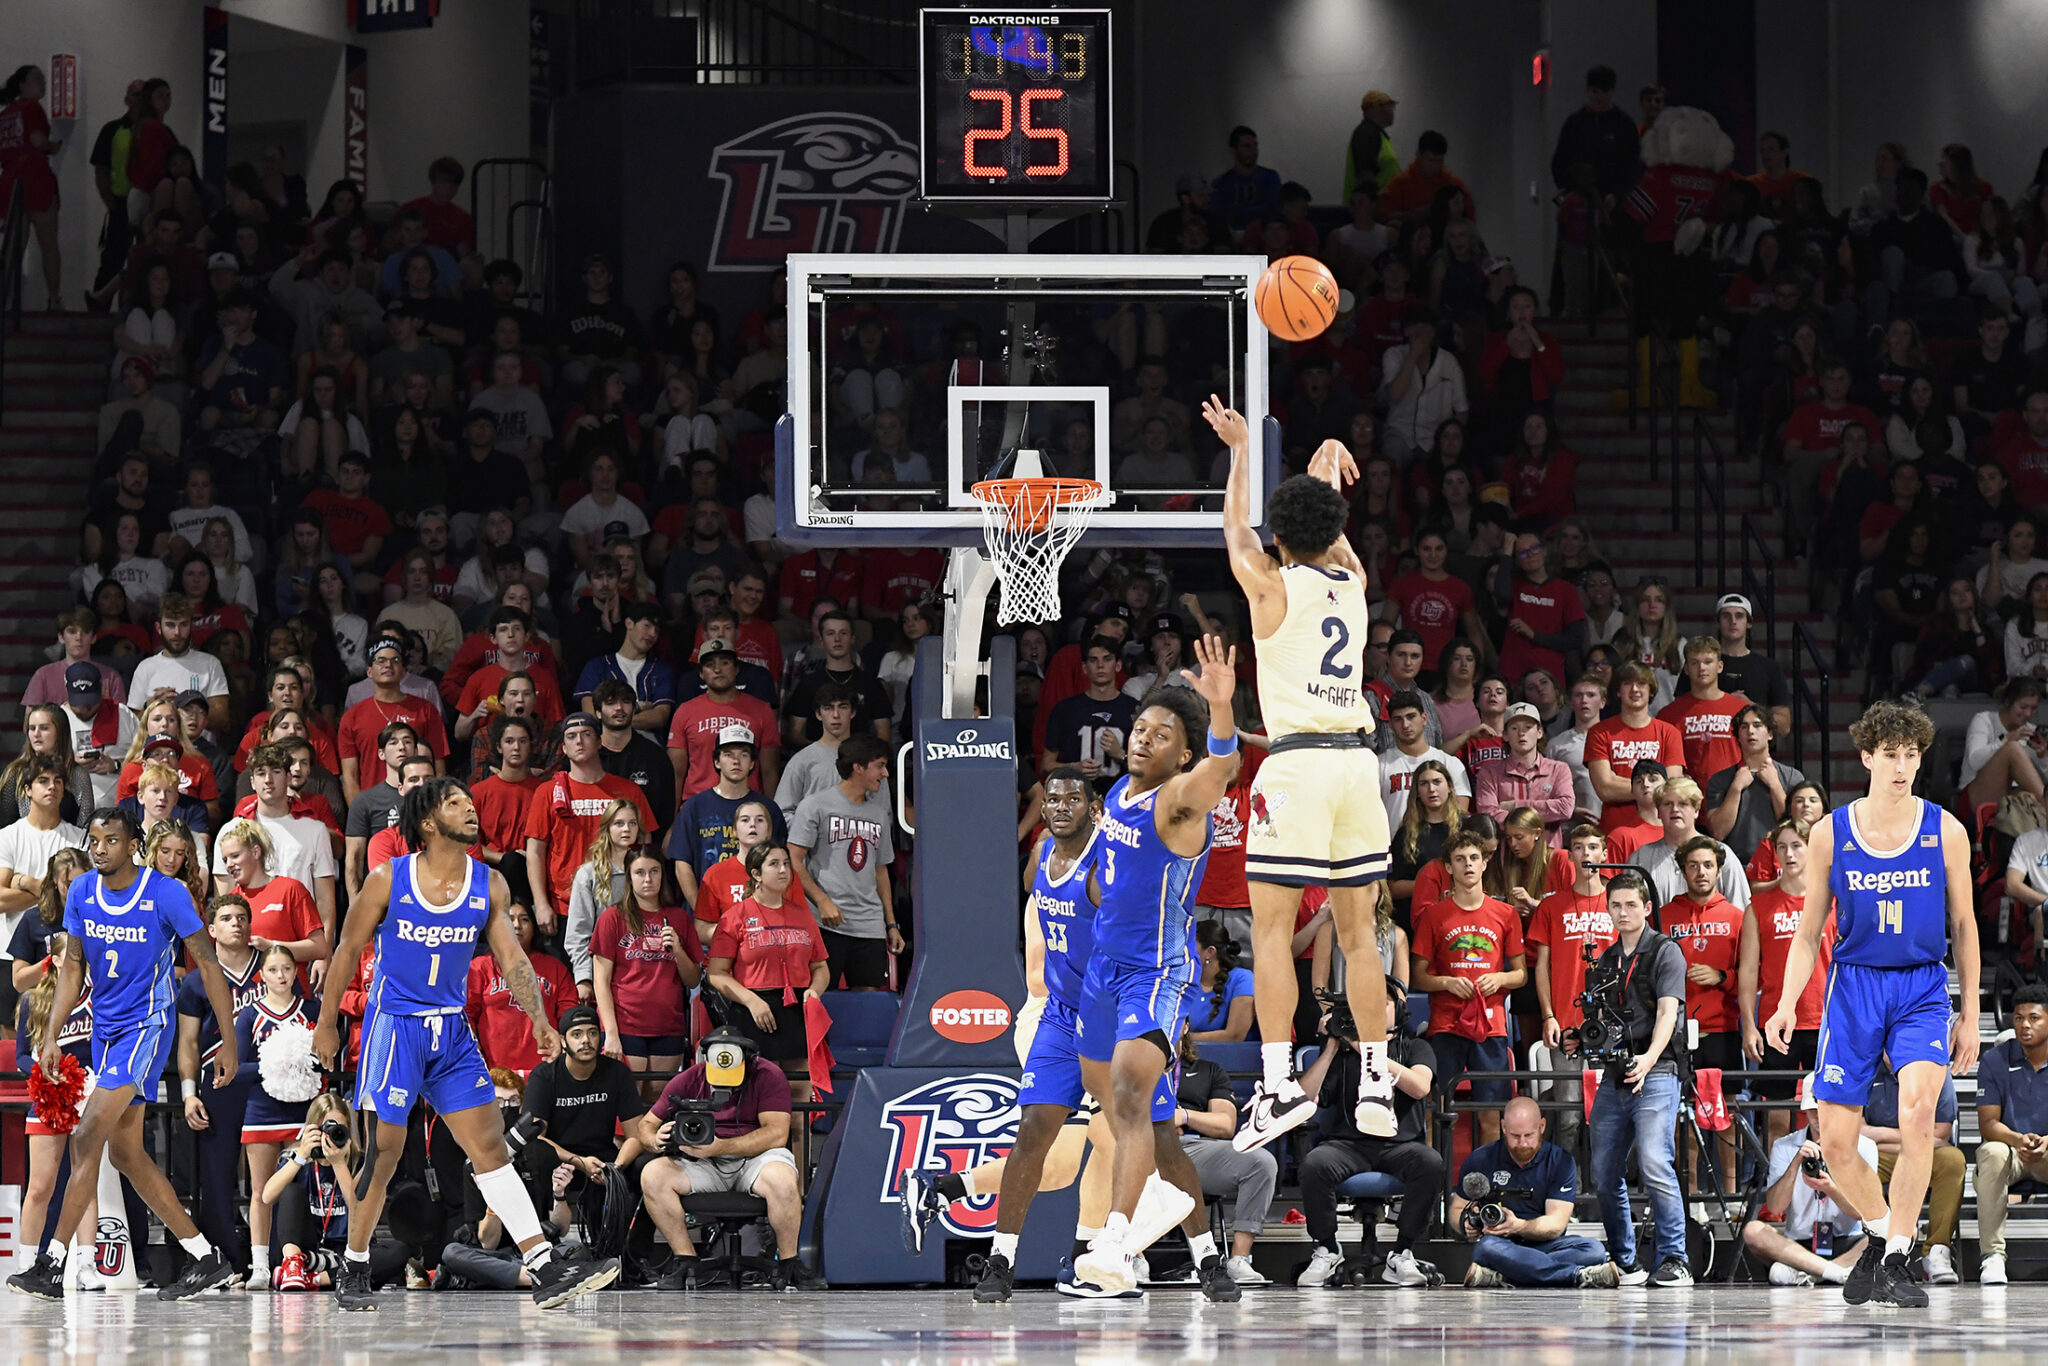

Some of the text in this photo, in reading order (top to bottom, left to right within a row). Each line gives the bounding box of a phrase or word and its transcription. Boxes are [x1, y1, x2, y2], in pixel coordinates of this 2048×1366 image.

[969, 15, 1057, 25] DAKTRONICS
[208, 48, 227, 134] MEN
[964, 89, 1066, 178] 25
[808, 515, 854, 526] SPALDING
[1317, 615, 1352, 679] 2
[697, 716, 752, 734] LIBERTY
[1684, 715, 1730, 726] FLAMES
[1685, 723, 1729, 734] NATION
[926, 742, 1013, 761] SPALDING
[1468, 748, 1508, 766] LIBER
[1611, 740, 1660, 752] FLAMES
[1613, 748, 1659, 760] NATION
[828, 816, 881, 844] FLAMES
[1104, 847, 1116, 886] 3
[1846, 867, 1931, 894] Regent
[1035, 889, 1076, 917] Regent
[1562, 911, 1612, 925] FLAMES
[1565, 921, 1613, 934] NATION
[1876, 899, 1903, 934] 14
[83, 918, 147, 944] Regent
[397, 918, 477, 948] Regent
[1046, 920, 1068, 953] 33
[1478, 925, 1498, 942] OPEN
[104, 949, 119, 979] 2
[427, 953, 440, 987] 1
[931, 1007, 1007, 1027] FOSTER
